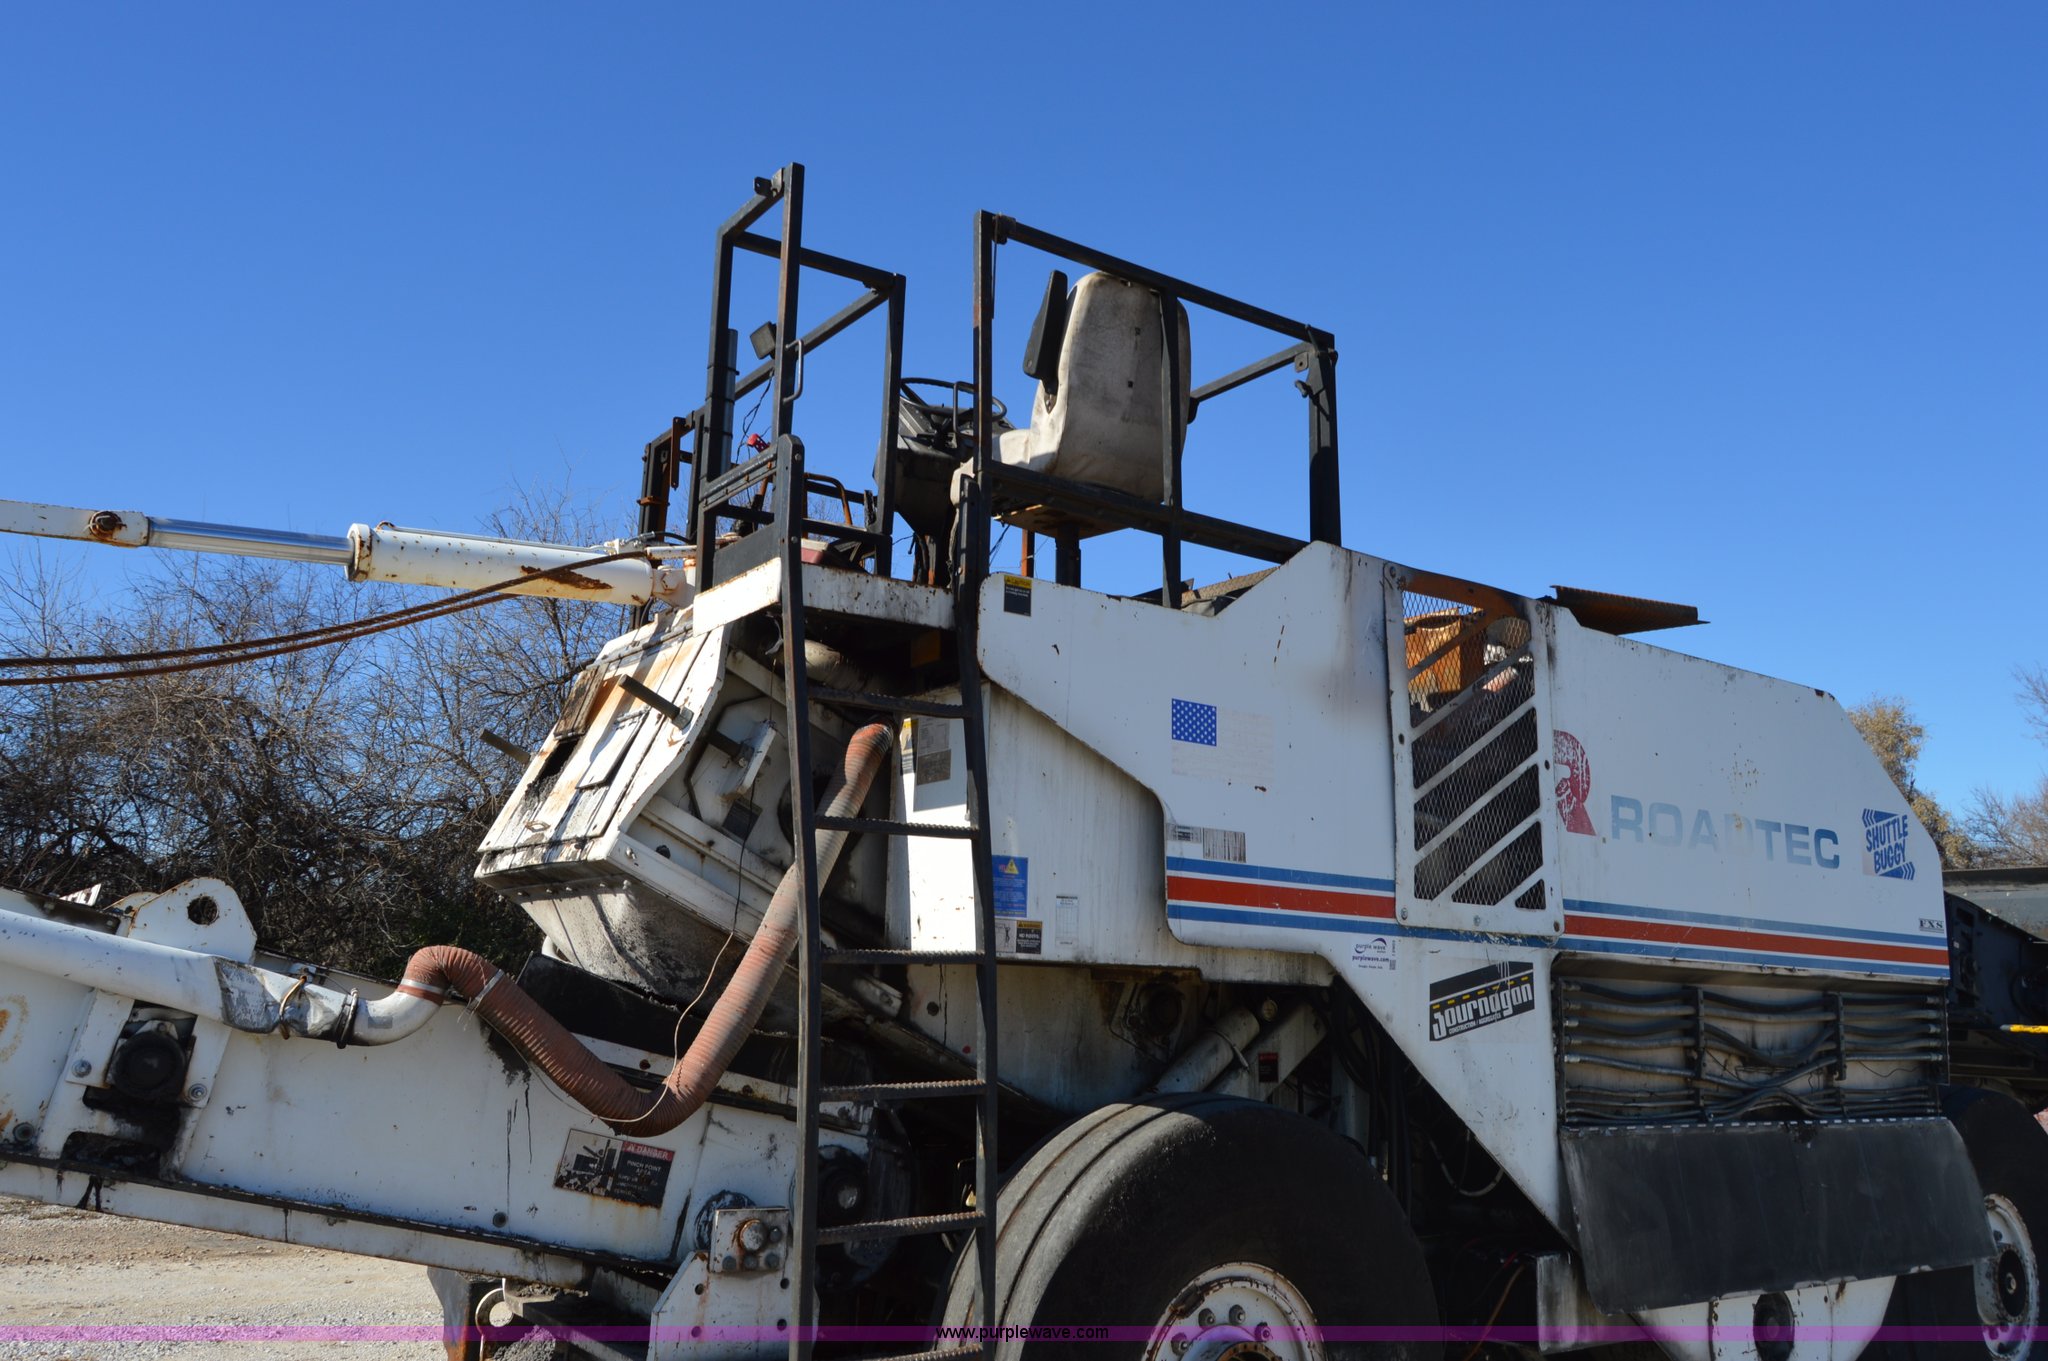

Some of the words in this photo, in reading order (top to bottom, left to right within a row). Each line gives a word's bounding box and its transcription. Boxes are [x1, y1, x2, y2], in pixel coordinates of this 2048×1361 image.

[1610, 795, 1840, 869] ROADTEC
[1866, 814, 1908, 852] SHUTTLE
[1873, 839, 1906, 873] BUGGY
[626, 1160, 644, 1169] PINCH
[644, 1163, 662, 1172] POINT
[636, 1144, 669, 1161] DANGER
